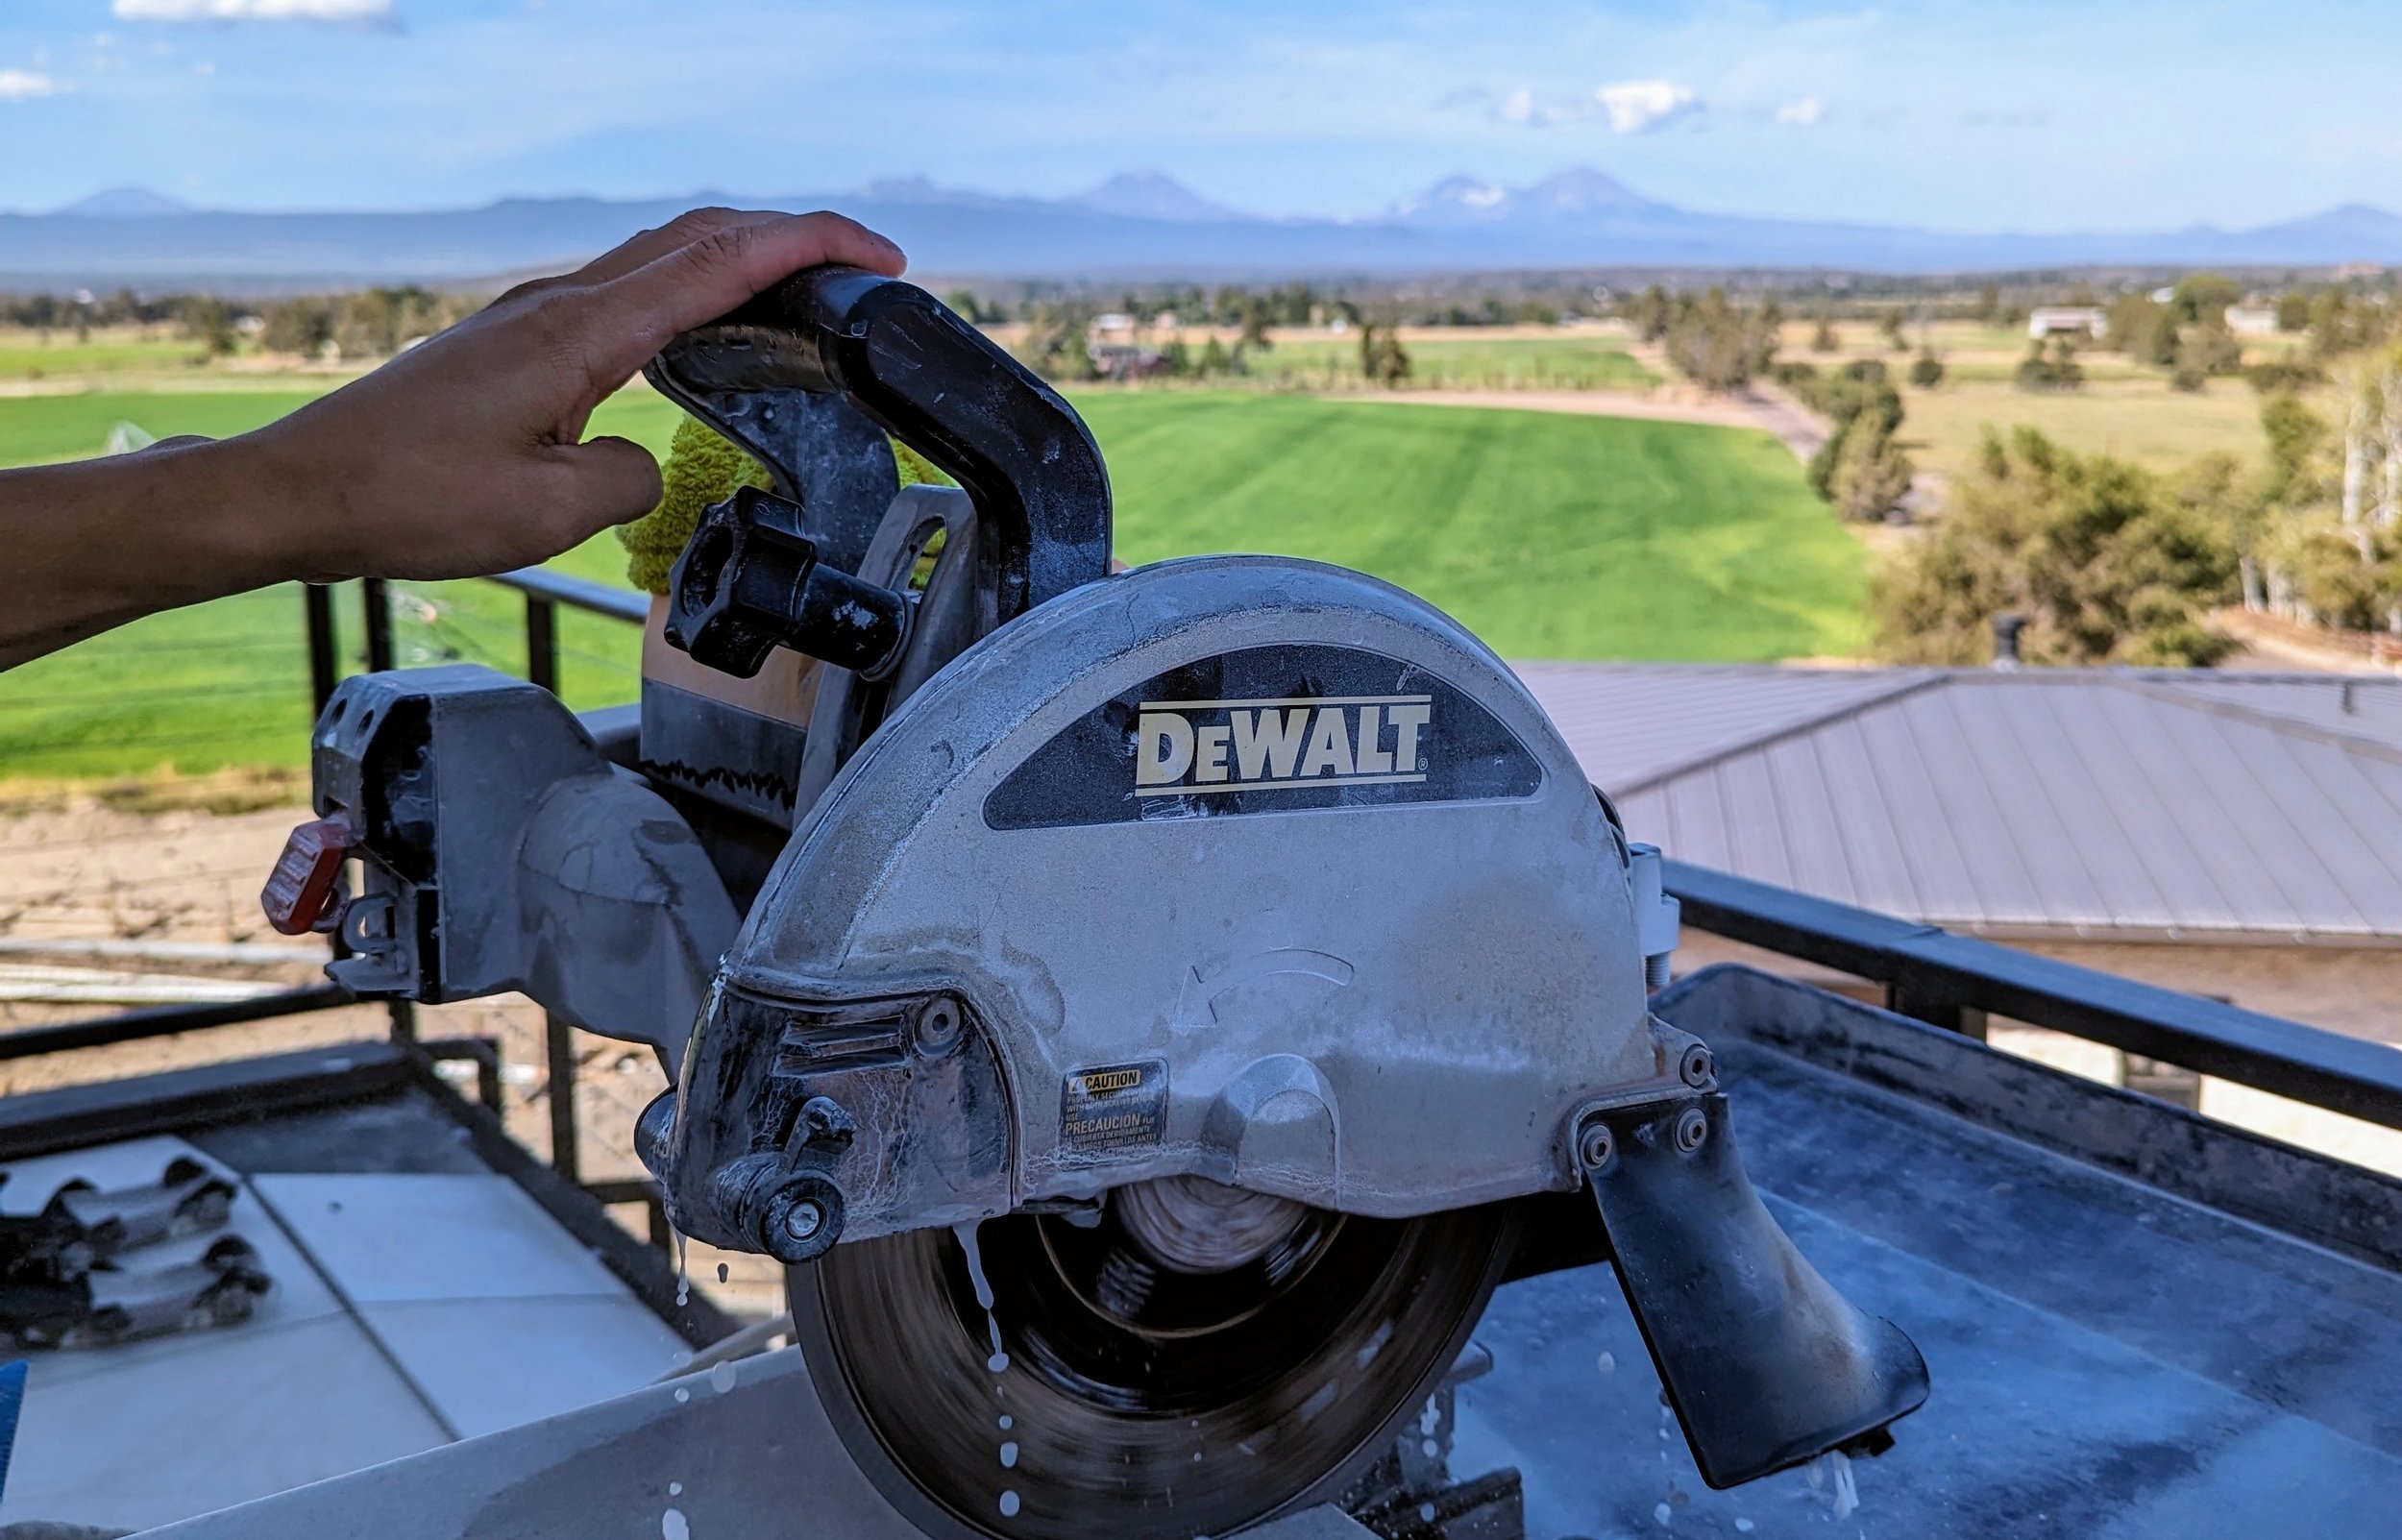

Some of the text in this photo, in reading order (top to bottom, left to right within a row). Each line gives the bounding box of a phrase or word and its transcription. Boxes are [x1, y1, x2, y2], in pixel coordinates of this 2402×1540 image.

[1085, 1071, 1137, 1089] CAUTION
[1066, 1105, 1084, 1113] WITH
[1066, 1113, 1140, 1135] PRECAUCION
[1073, 1132, 1105, 1142] CUBIERTA
